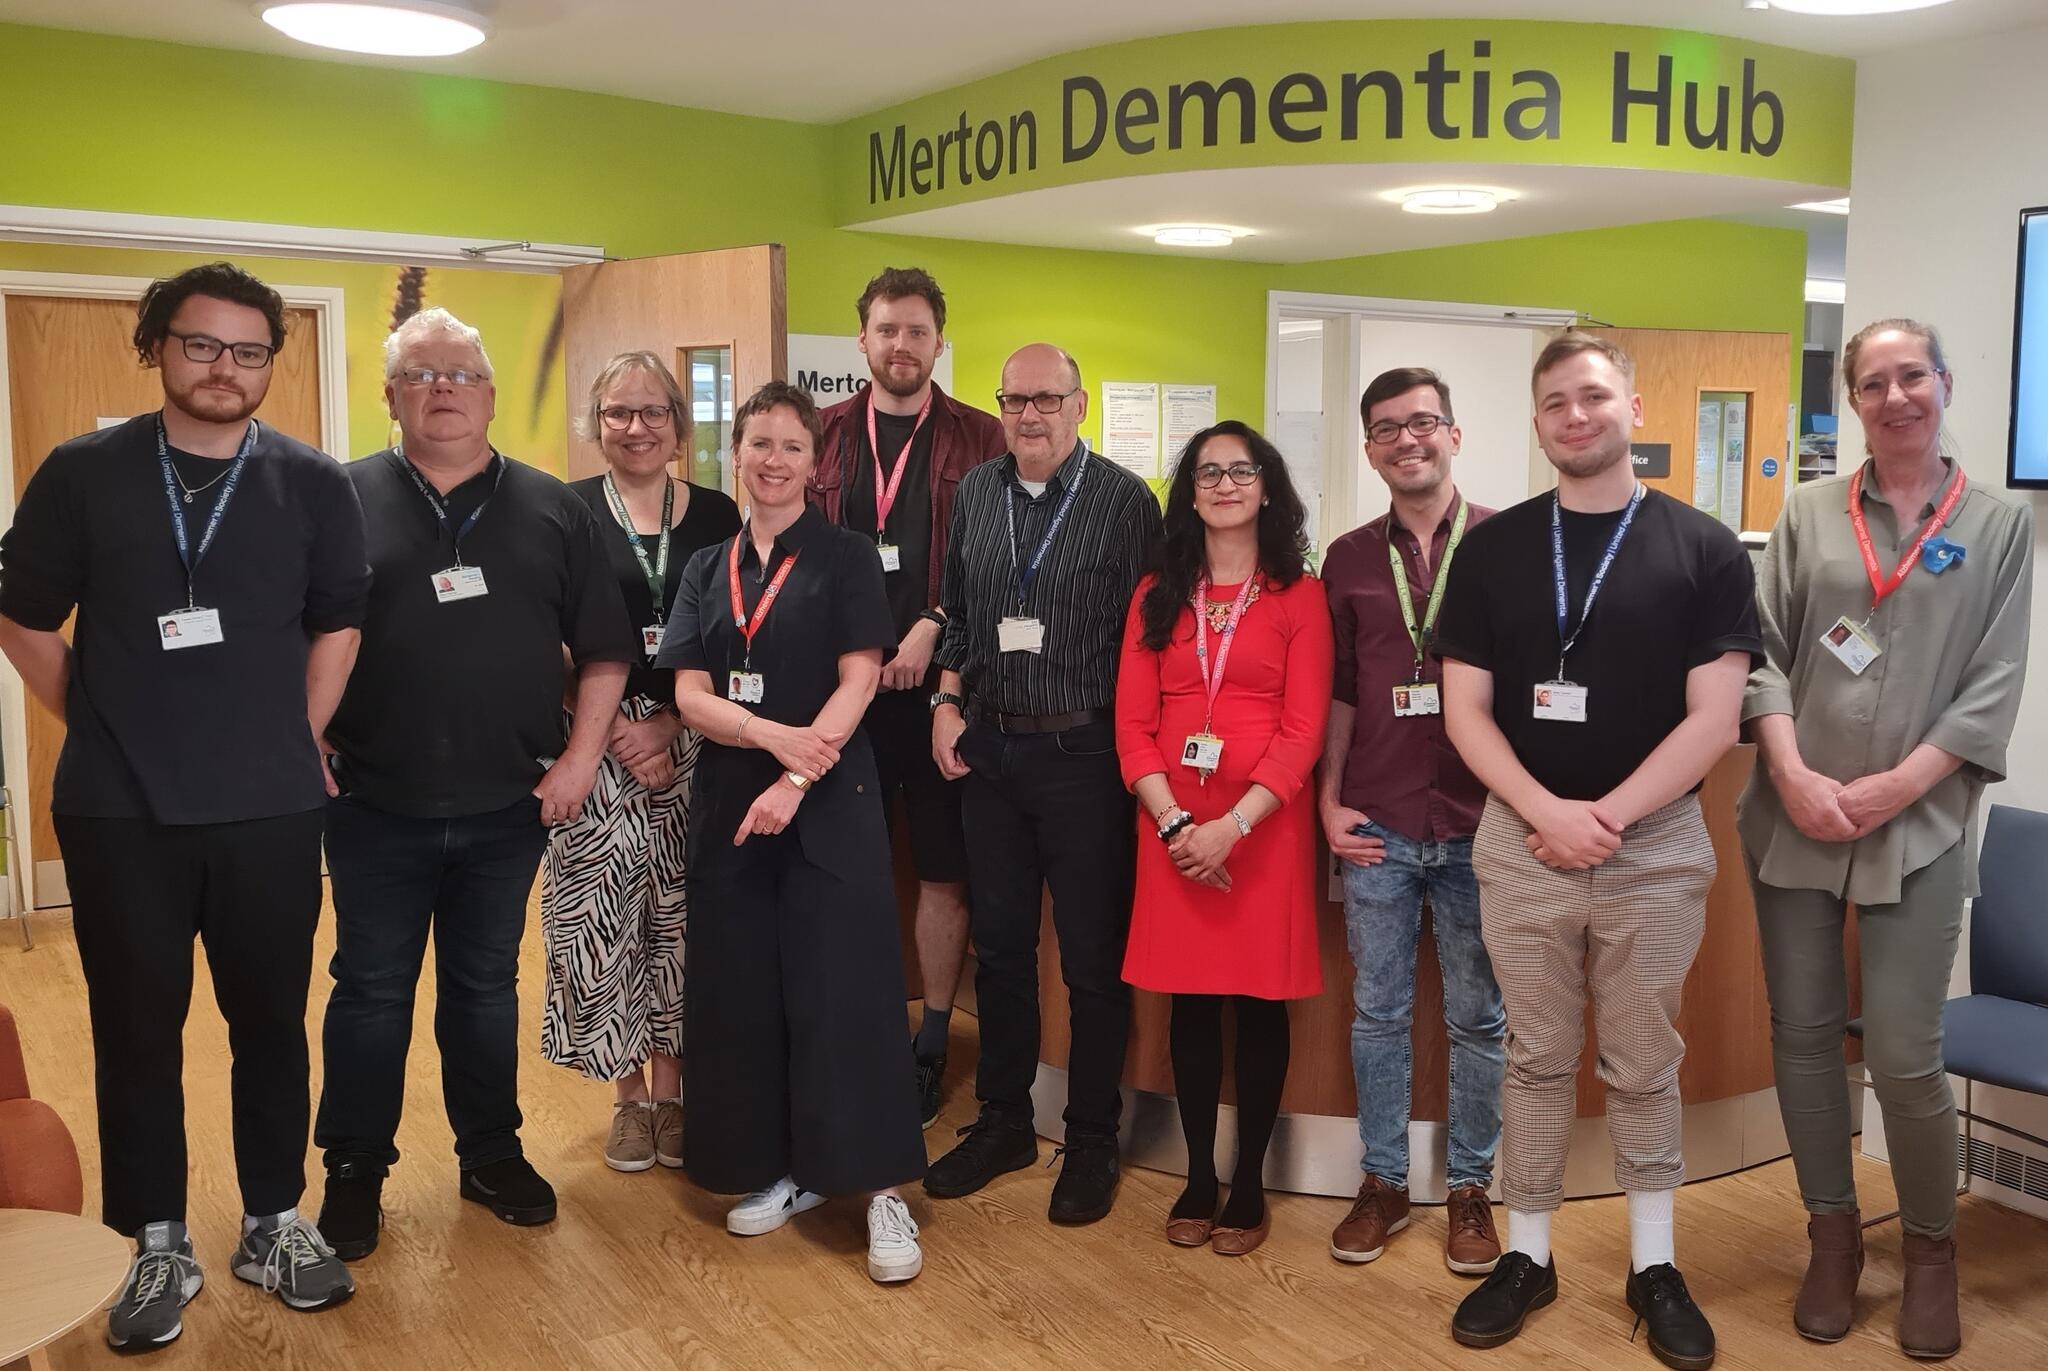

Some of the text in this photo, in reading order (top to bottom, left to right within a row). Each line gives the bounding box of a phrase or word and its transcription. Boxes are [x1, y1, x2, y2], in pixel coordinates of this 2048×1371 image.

[870, 41, 1785, 205] Merton Dementia Hub
[797, 370, 870, 393] Merto
[1631, 454, 1649, 465] fice
[1070, 471, 1082, 492] Society
[161, 459, 172, 483] United
[174, 512, 187, 550] Dementia
[215, 485, 232, 512] Society
[1059, 496, 1071, 516] United
[1046, 515, 1061, 540] Against
[1597, 552, 1614, 579] Society
[1610, 526, 1624, 550] United
[1620, 501, 1636, 527] Against
[1554, 530, 1562, 552] United
[1031, 539, 1049, 570] Dementia
[1553, 554, 1563, 580] Against
[1557, 581, 1567, 616] Dementia
